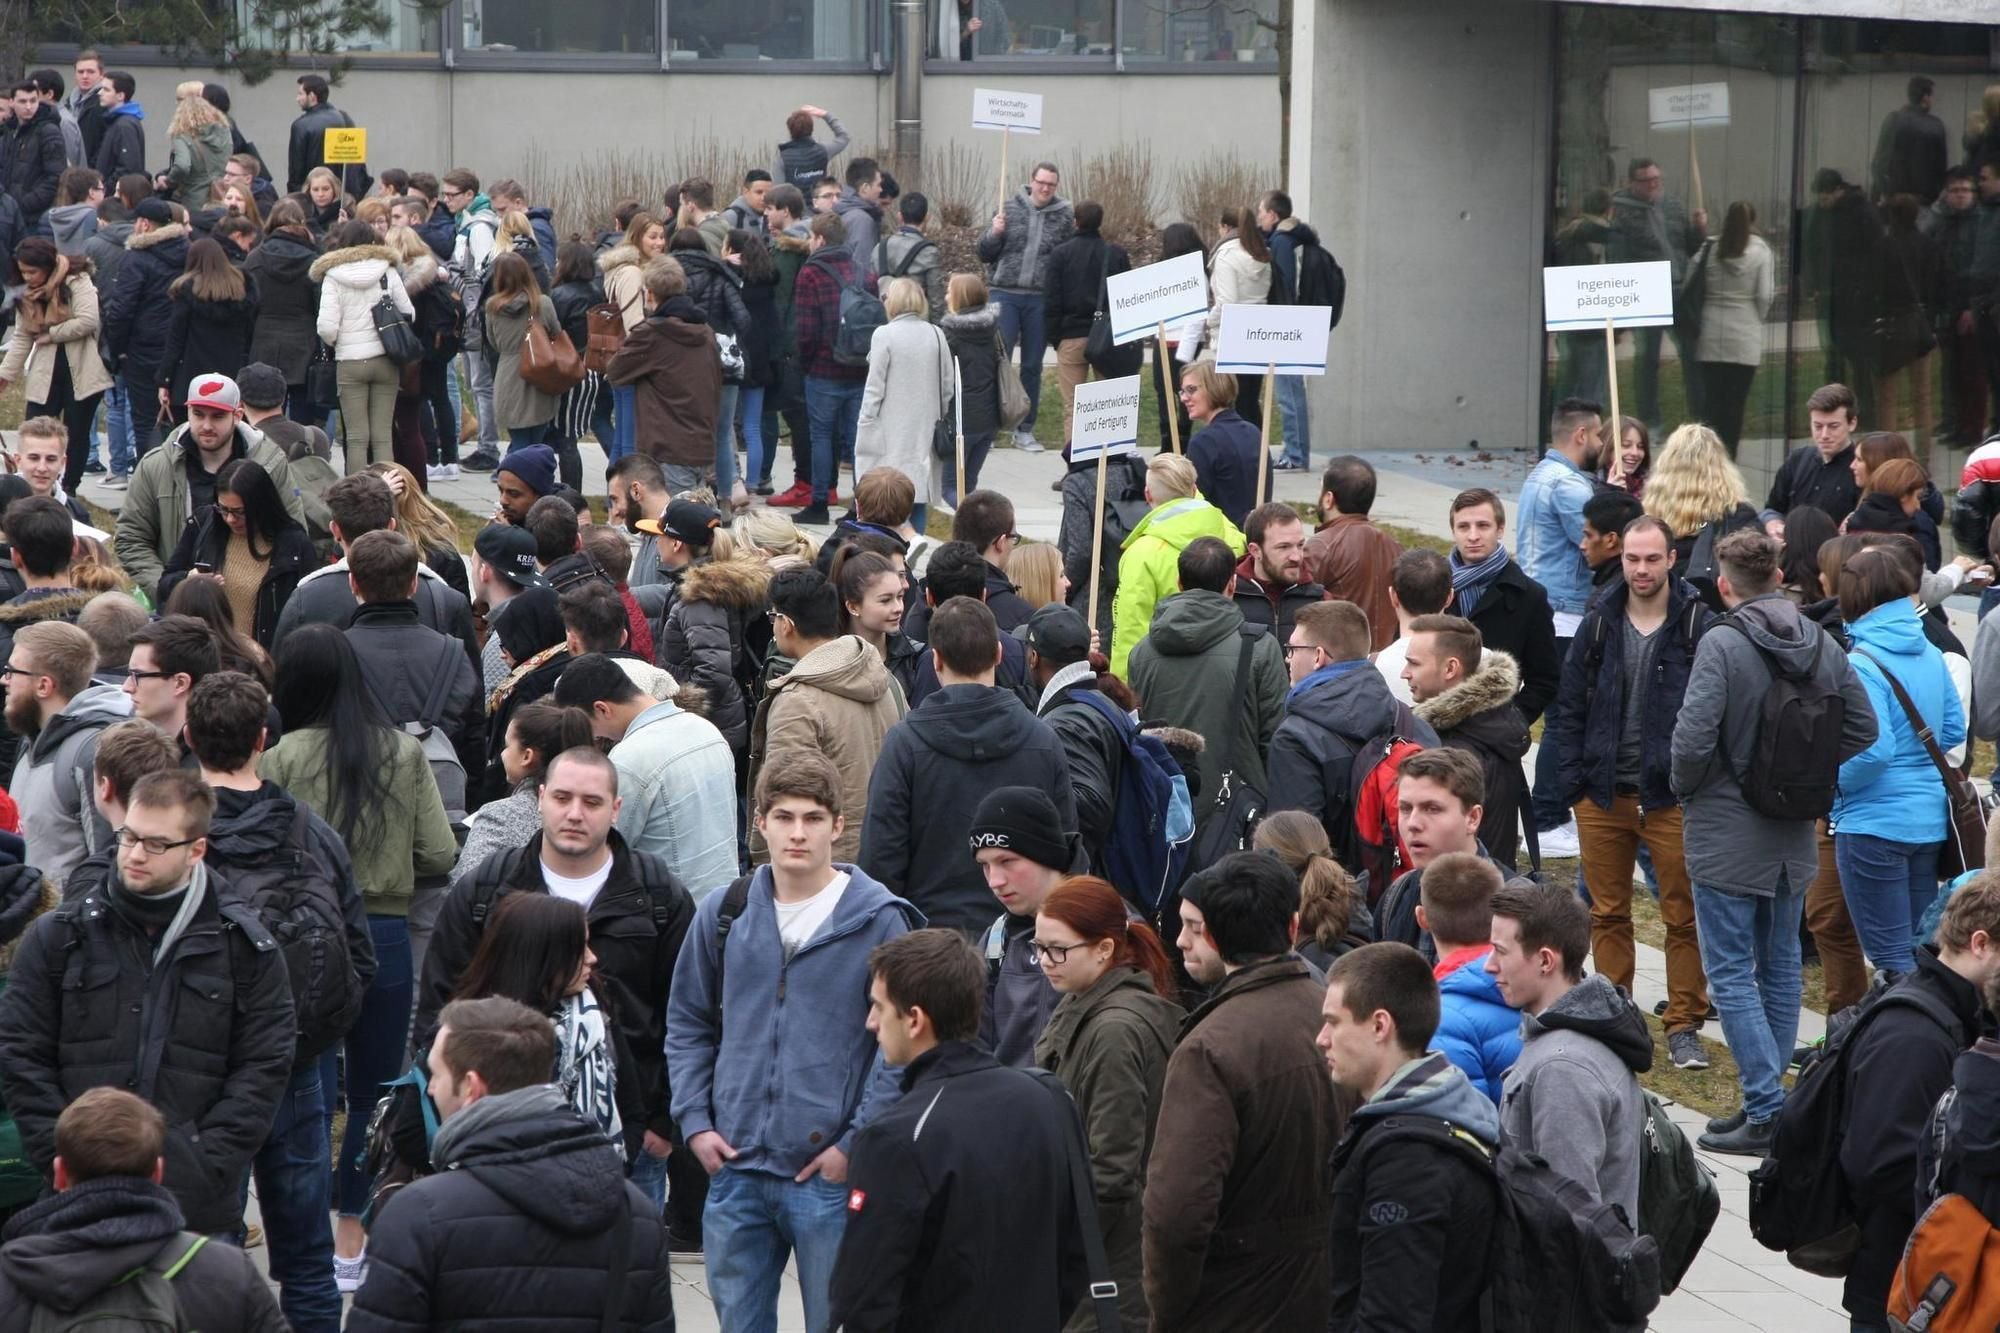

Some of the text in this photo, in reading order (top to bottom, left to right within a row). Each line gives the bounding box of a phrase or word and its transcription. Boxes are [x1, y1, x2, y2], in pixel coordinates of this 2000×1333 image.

[988, 98, 1029, 109] Wirtschafts-
[1116, 276, 1200, 310] Medieninformatik
[1577, 278, 1639, 293] Ingenieur-
[1577, 293, 1640, 309] pädagogik
[1246, 328, 1303, 341] Informatik
[1076, 393, 1138, 414] Produktentwicklung
[1084, 415, 1128, 432] und Fertigung
